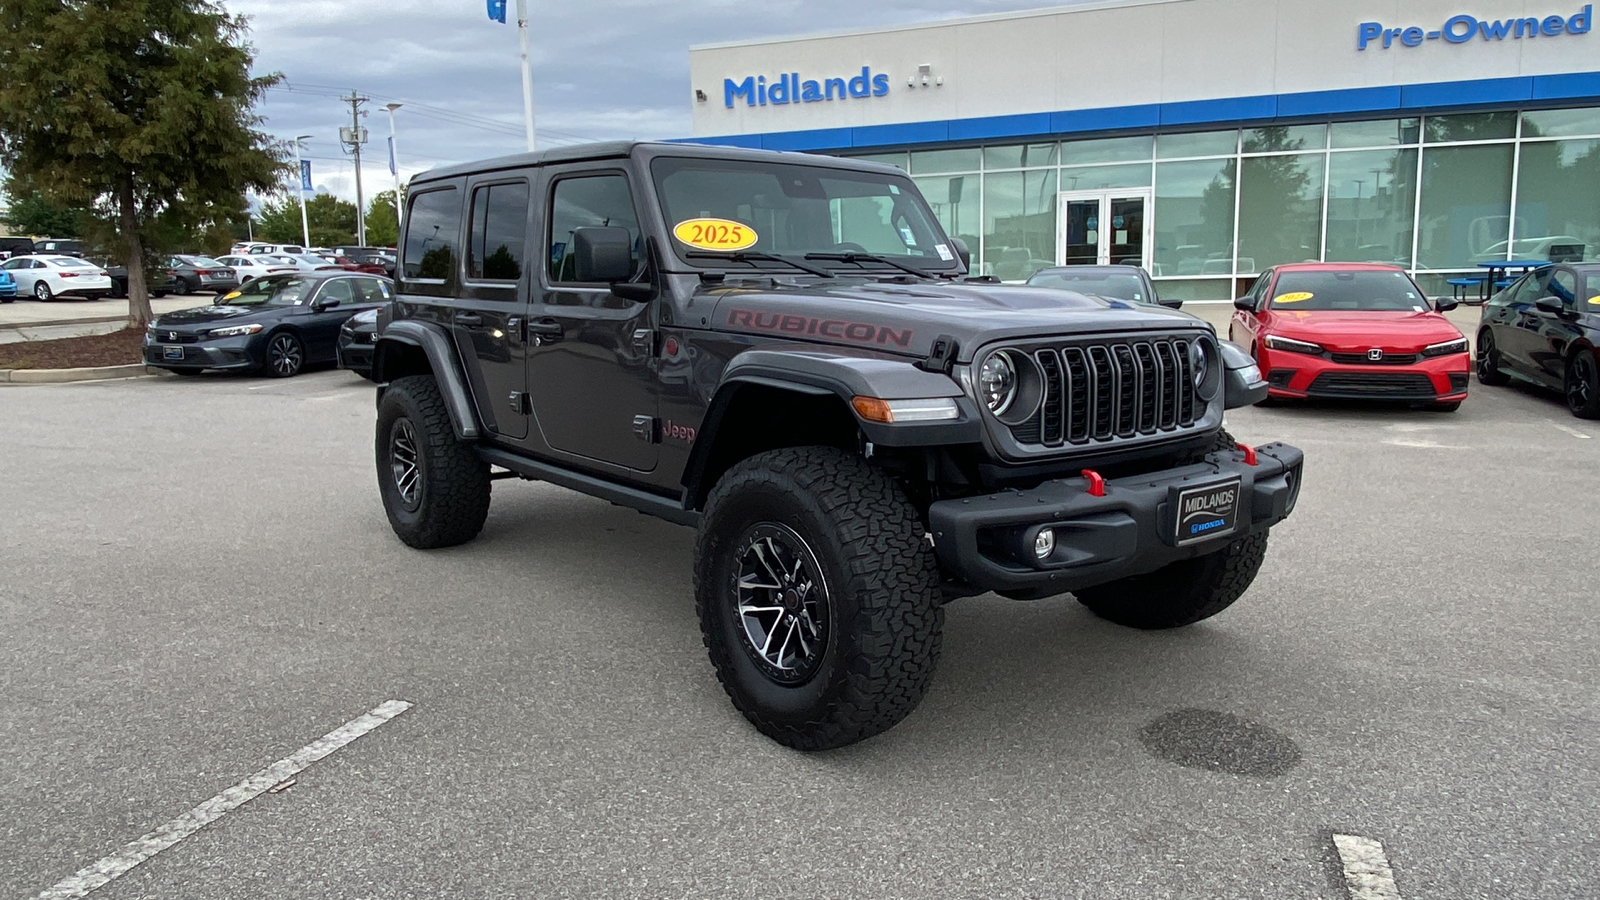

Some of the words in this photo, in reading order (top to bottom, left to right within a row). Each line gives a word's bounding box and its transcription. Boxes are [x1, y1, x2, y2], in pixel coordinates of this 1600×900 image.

[1357, 4, 1593, 51] Pre-Owned
[724, 66, 889, 108] Midlands
[691, 224, 742, 244] 2025
[727, 309, 914, 347] RUBICON
[662, 419, 696, 444] Jeep
[1185, 490, 1234, 513] MIDLANDS
[1198, 519, 1225, 531] HONDA
